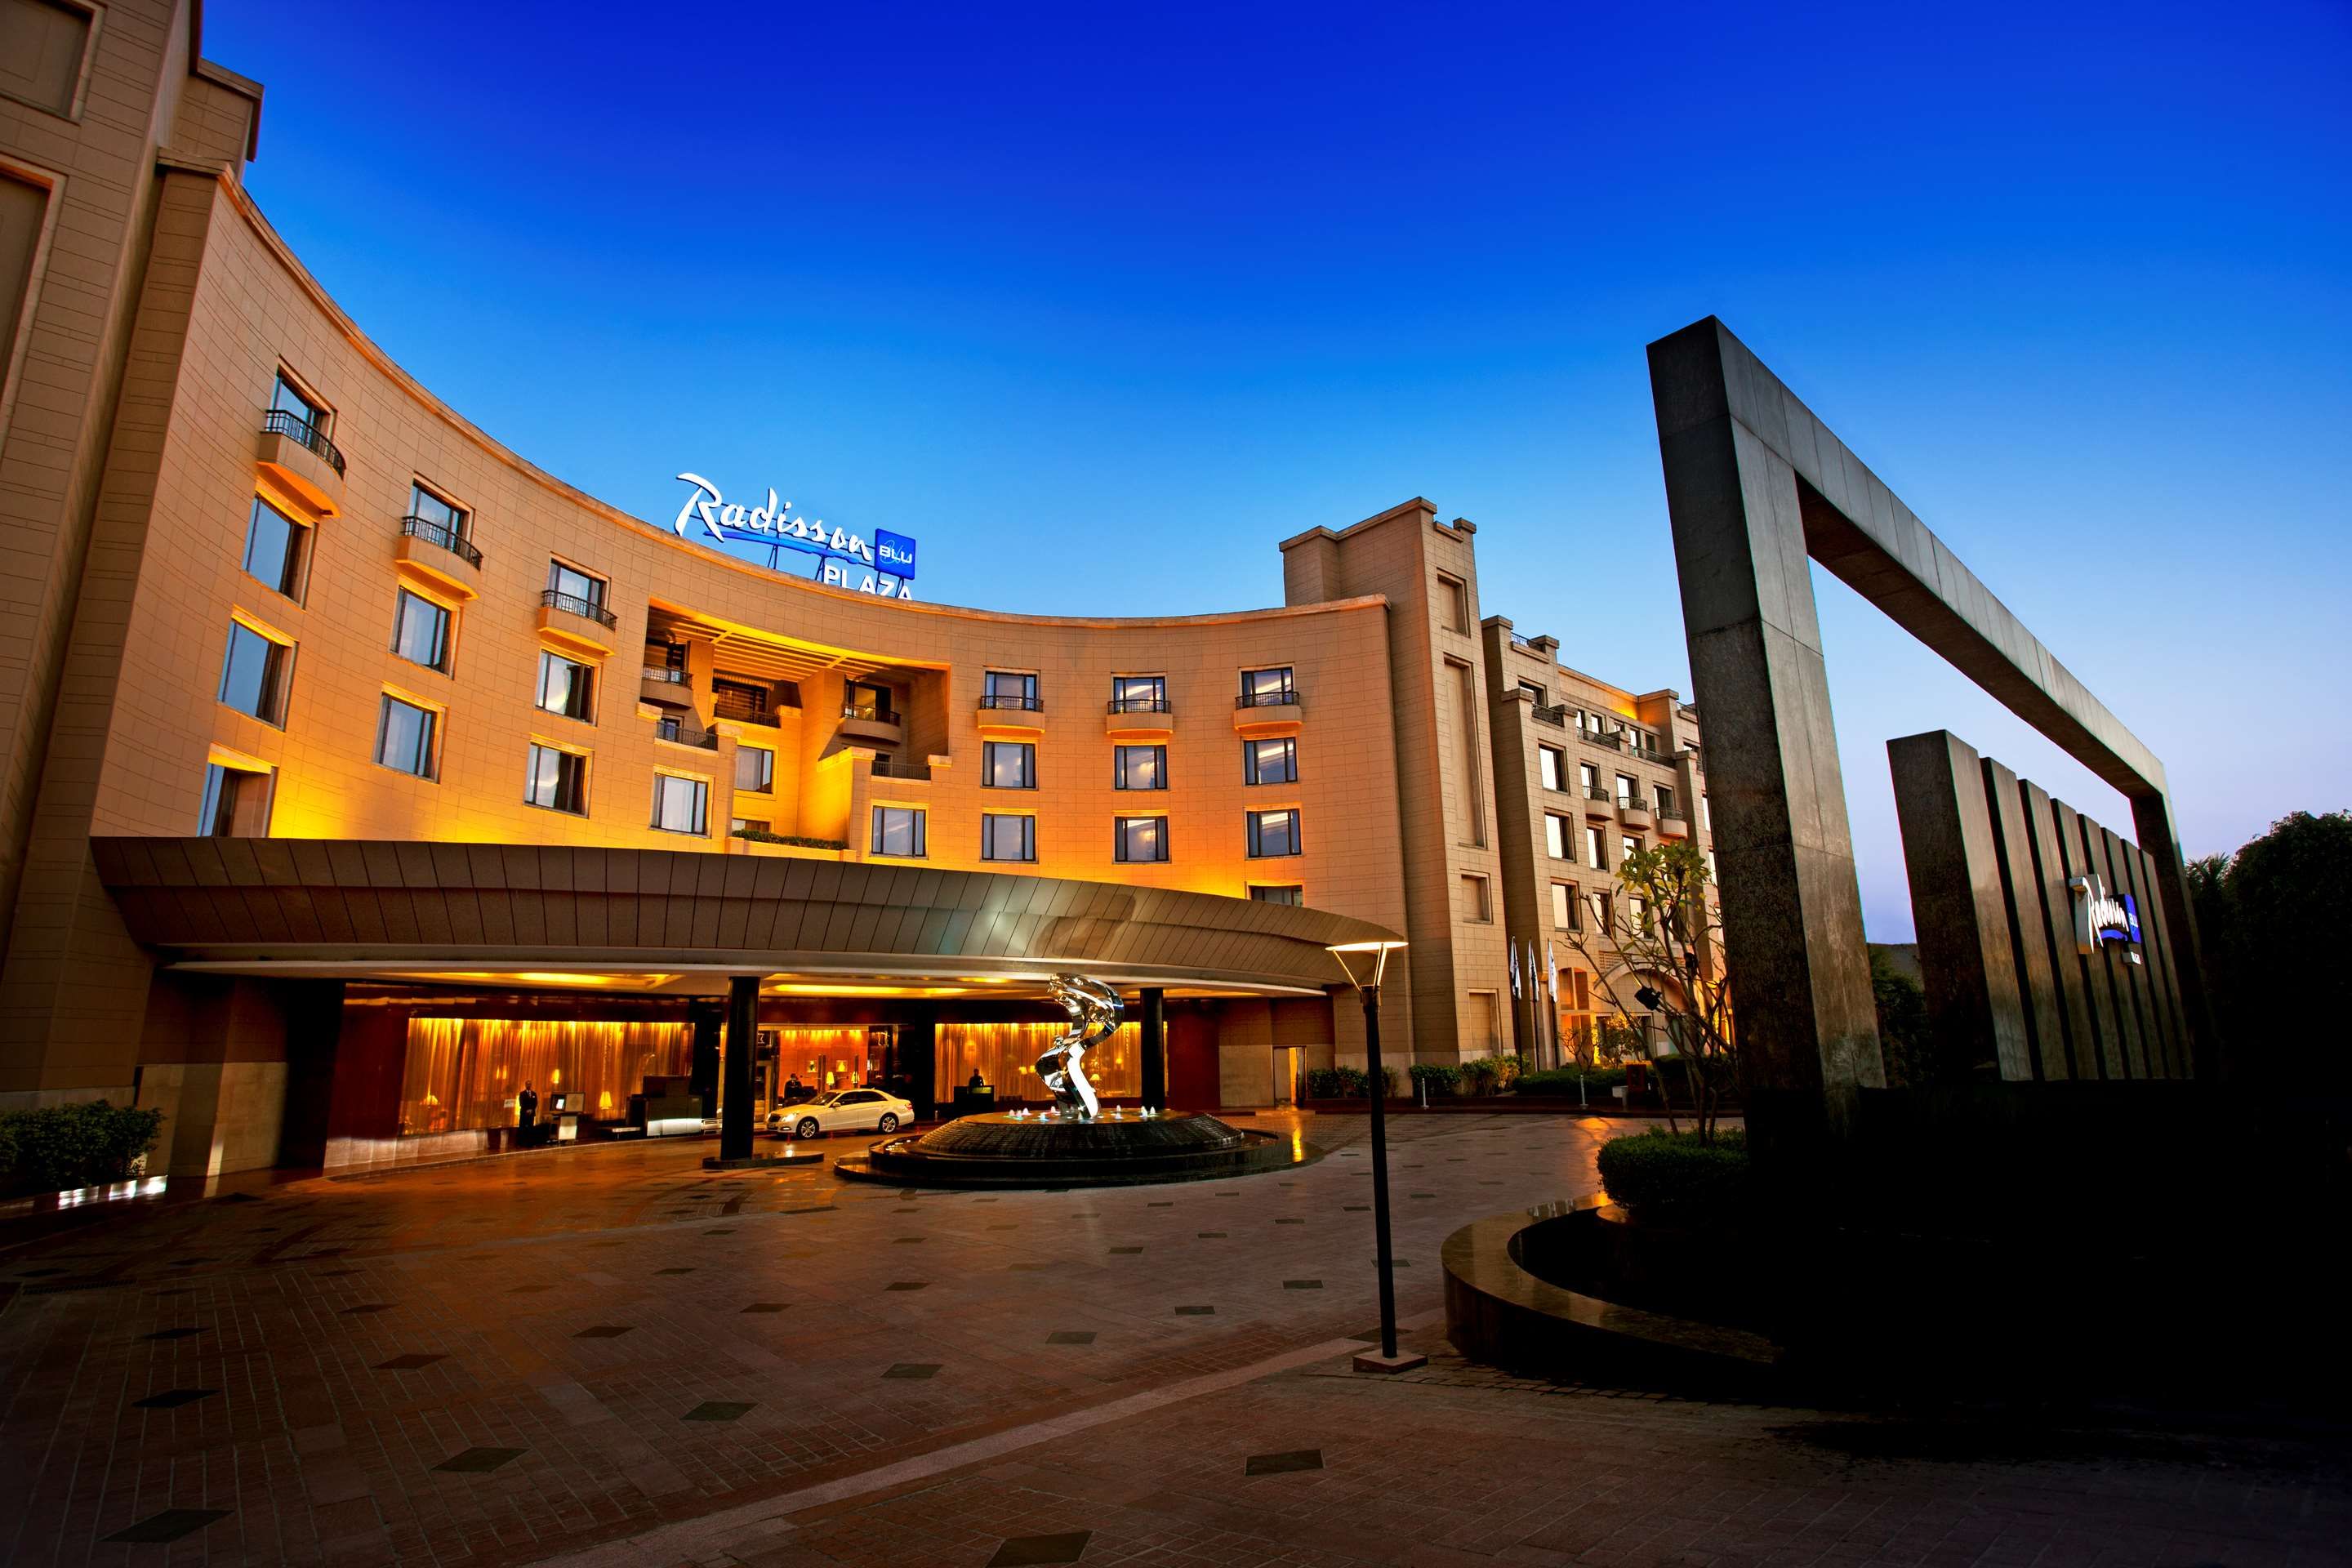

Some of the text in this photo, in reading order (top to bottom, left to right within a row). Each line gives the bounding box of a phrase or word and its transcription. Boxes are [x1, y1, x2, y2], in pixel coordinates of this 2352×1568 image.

[675, 472, 913, 564] Radisson BLU
[823, 564, 913, 601] PLAZA
